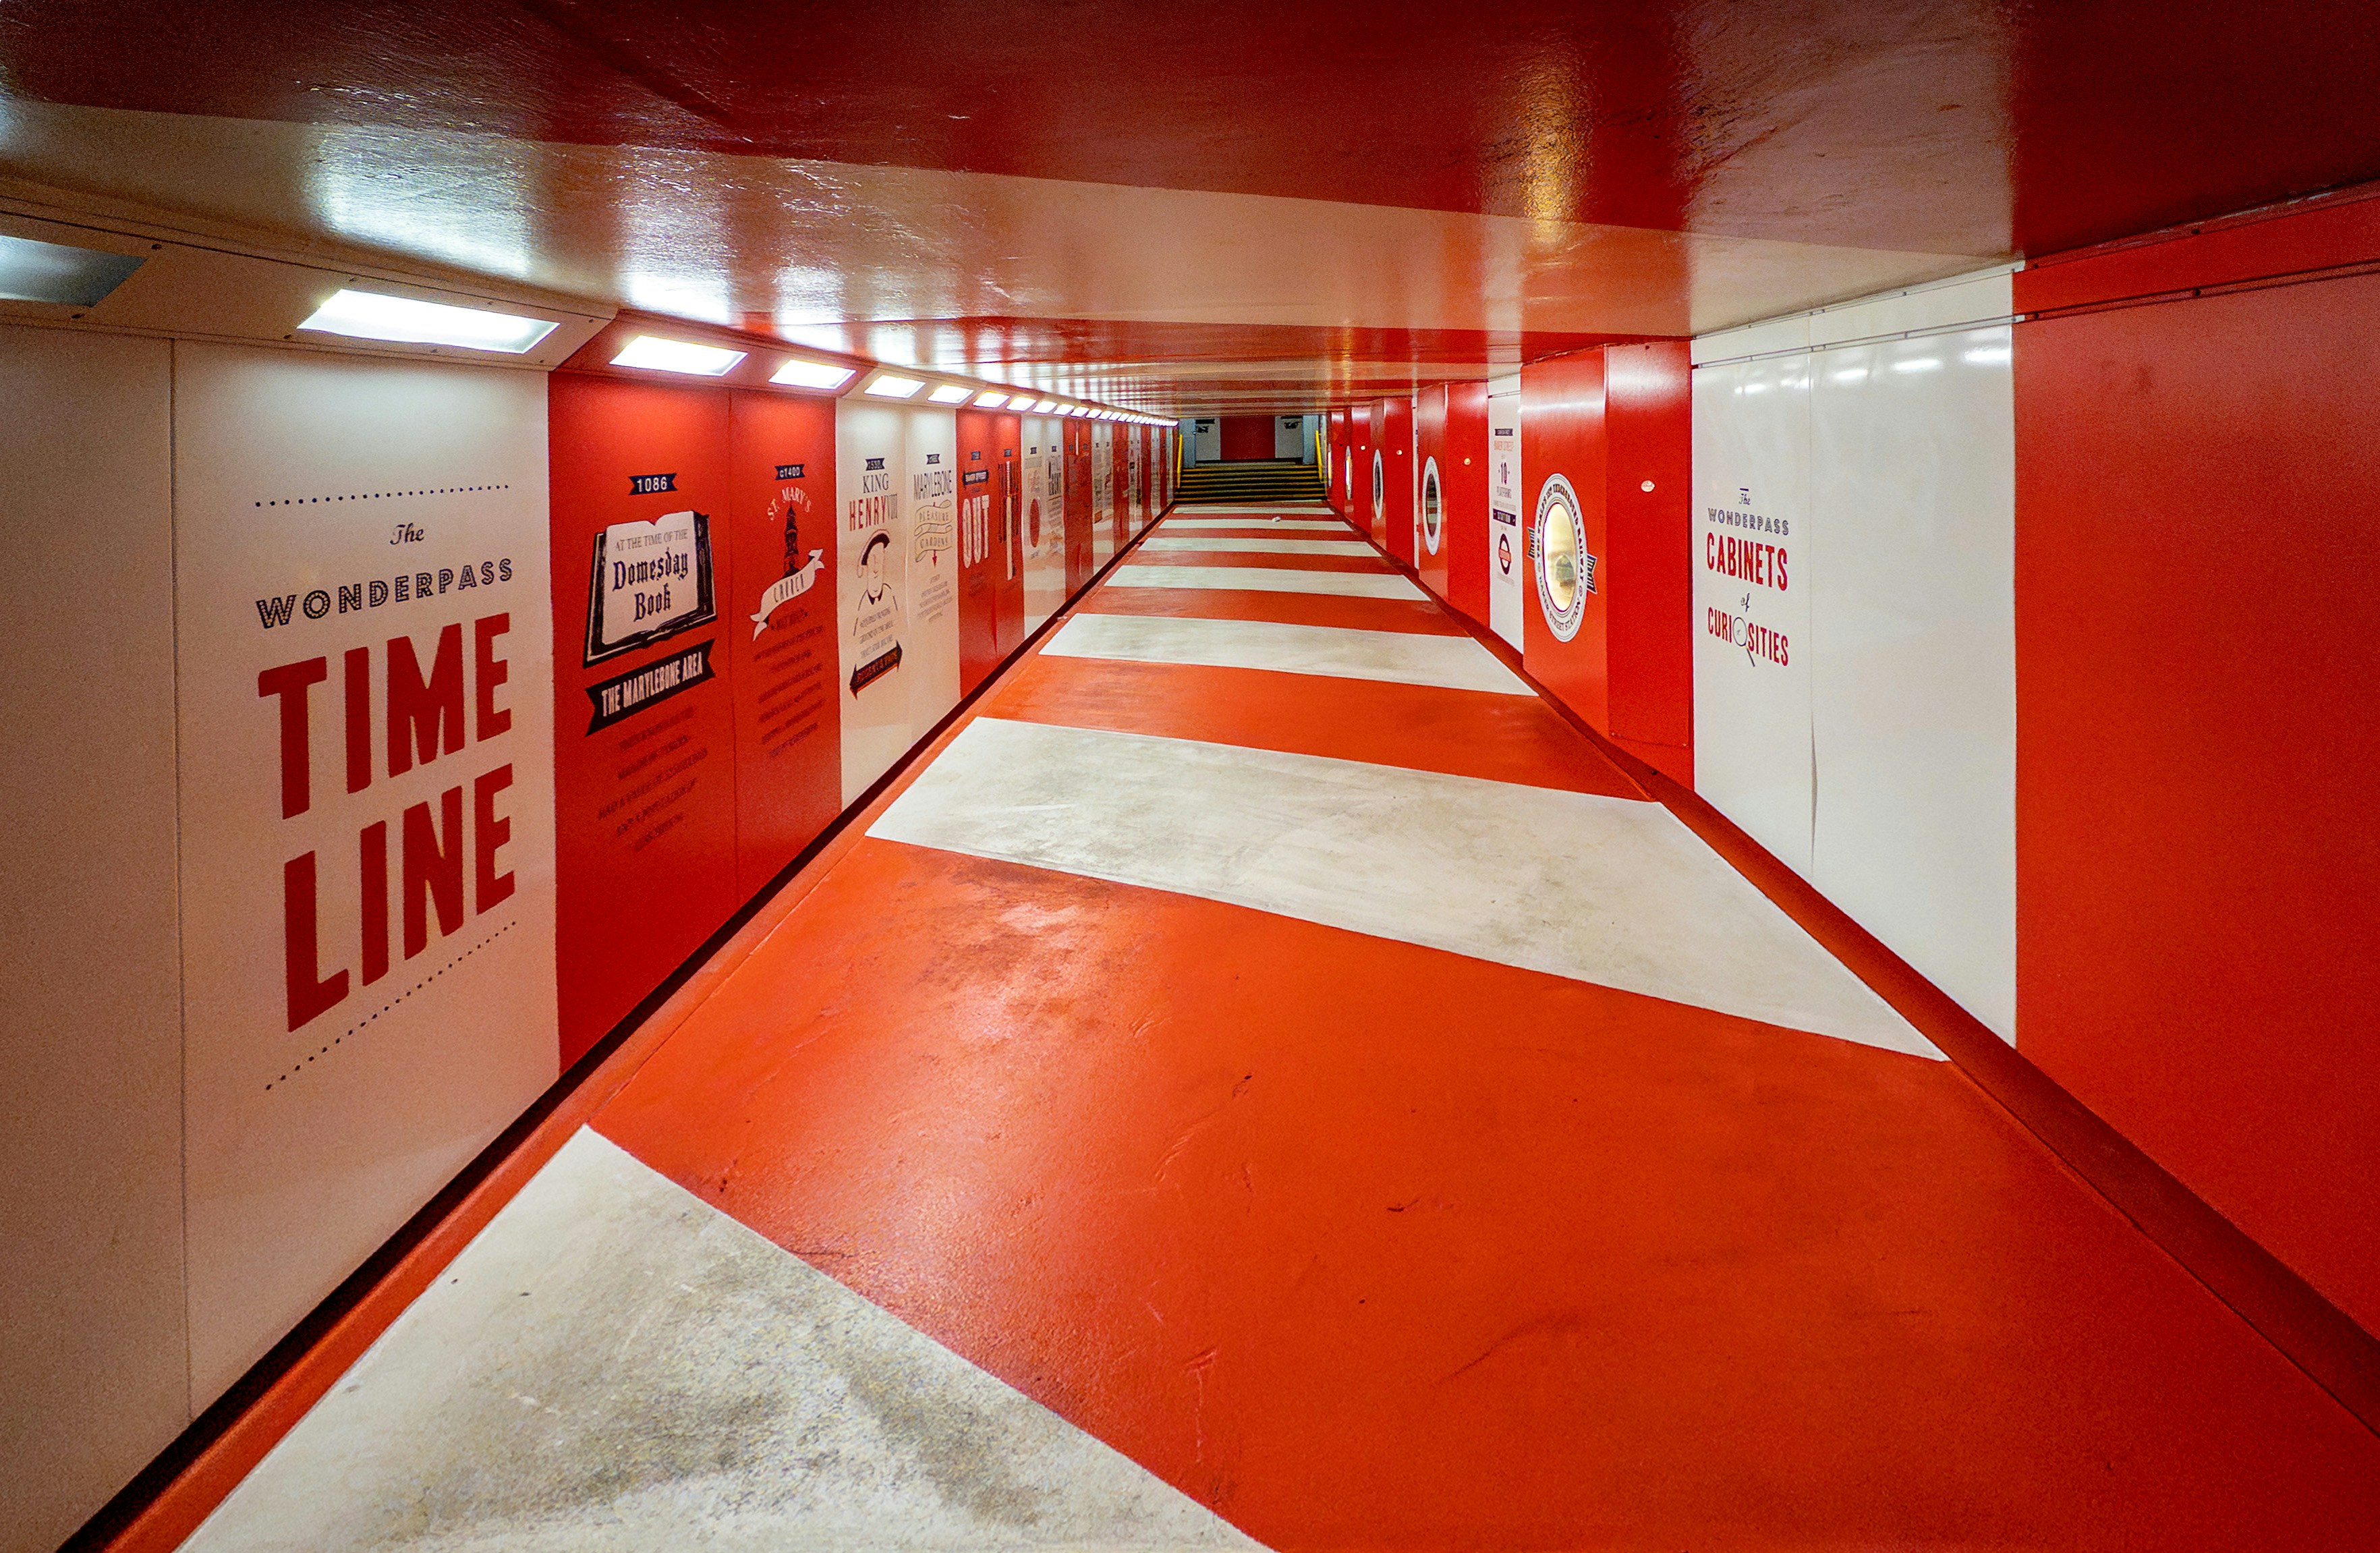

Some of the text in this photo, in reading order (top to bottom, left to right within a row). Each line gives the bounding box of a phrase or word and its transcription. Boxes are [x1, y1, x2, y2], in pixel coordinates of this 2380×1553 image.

[637, 476, 667, 492] 1086
[862, 473, 889, 494] KING
[849, 495, 886, 532] HENRY
[1707, 507, 1789, 536] WONDERPASS
[390, 523, 425, 545] The
[616, 529, 689, 551] AT THE TIME OF THE
[612, 546, 688, 592] Domesday
[1707, 532, 1788, 592] CABINETS
[256, 558, 513, 629] WONDERPASS
[633, 582, 671, 622] Book
[1740, 593, 1751, 613] of
[601, 651, 703, 717] THE MARYLEBONE AREA
[258, 613, 511, 819] TIME
[284, 763, 515, 1032] LINE
